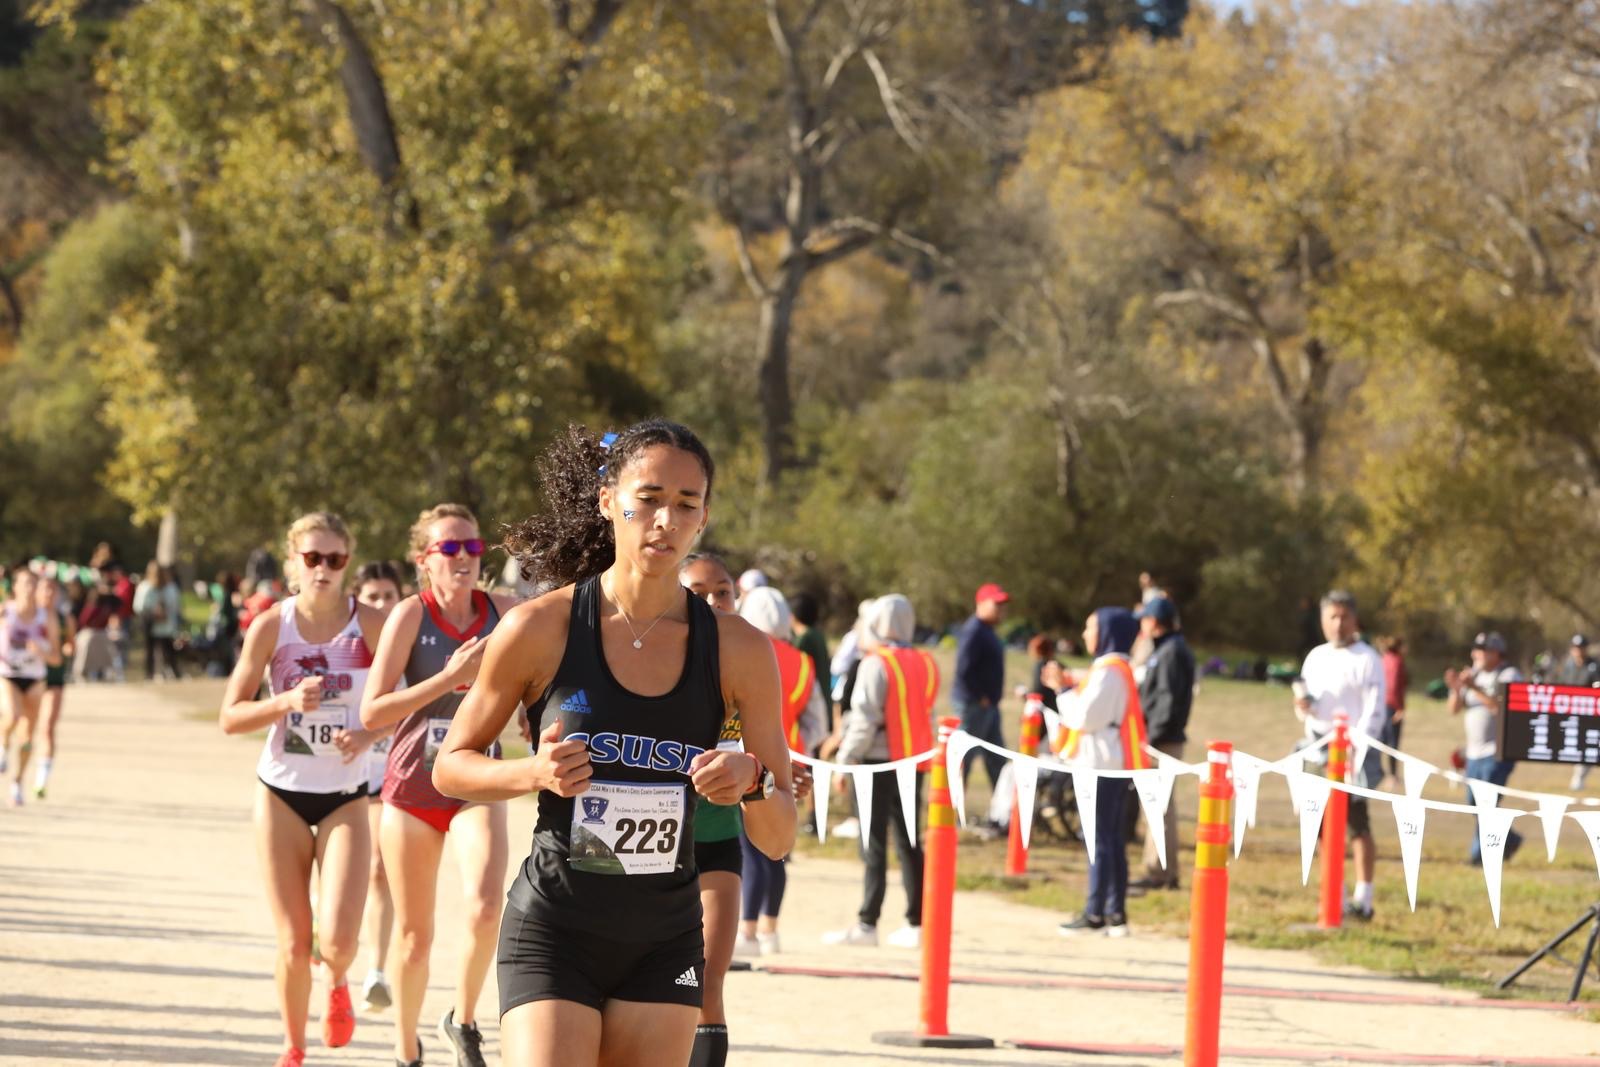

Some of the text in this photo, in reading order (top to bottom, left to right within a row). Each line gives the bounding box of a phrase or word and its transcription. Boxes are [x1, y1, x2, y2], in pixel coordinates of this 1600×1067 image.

[560, 702, 592, 714] adidas
[1527, 684, 1600, 716] Wom
[1528, 713, 1600, 763] 11:
[614, 818, 678, 854] 223
[675, 977, 699, 988] adidas
